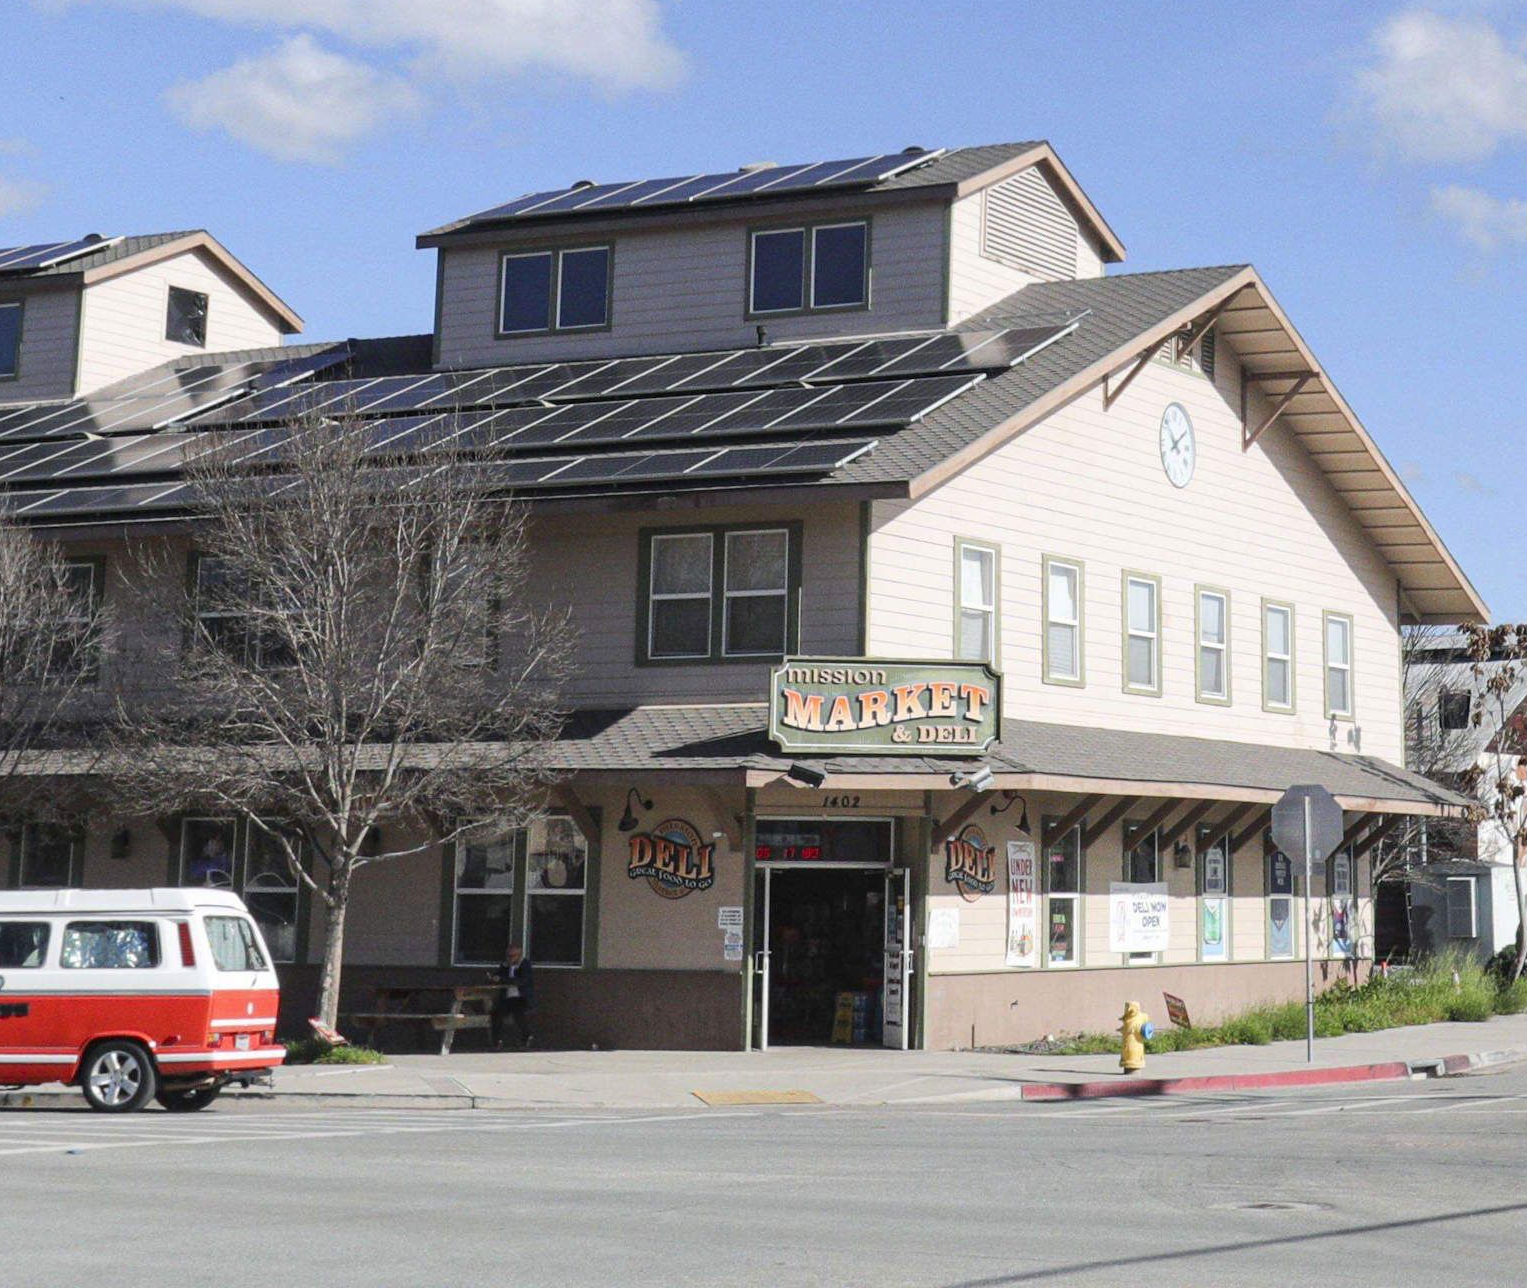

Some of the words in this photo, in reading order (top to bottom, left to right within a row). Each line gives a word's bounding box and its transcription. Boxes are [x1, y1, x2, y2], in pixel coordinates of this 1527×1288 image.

[782, 680, 991, 732] MARKET
[891, 724, 913, 744] &
[917, 724, 979, 744] DELI
[822, 795, 861, 808] 1402
[629, 836, 713, 880] DELI
[948, 840, 996, 883] DELI
[1010, 858, 1033, 877] UNDER
[1011, 879, 1033, 905] NEW
[1132, 901, 1149, 914] DELI
[1151, 901, 1167, 913] NOW
[1141, 915, 1161, 928] OPEN
